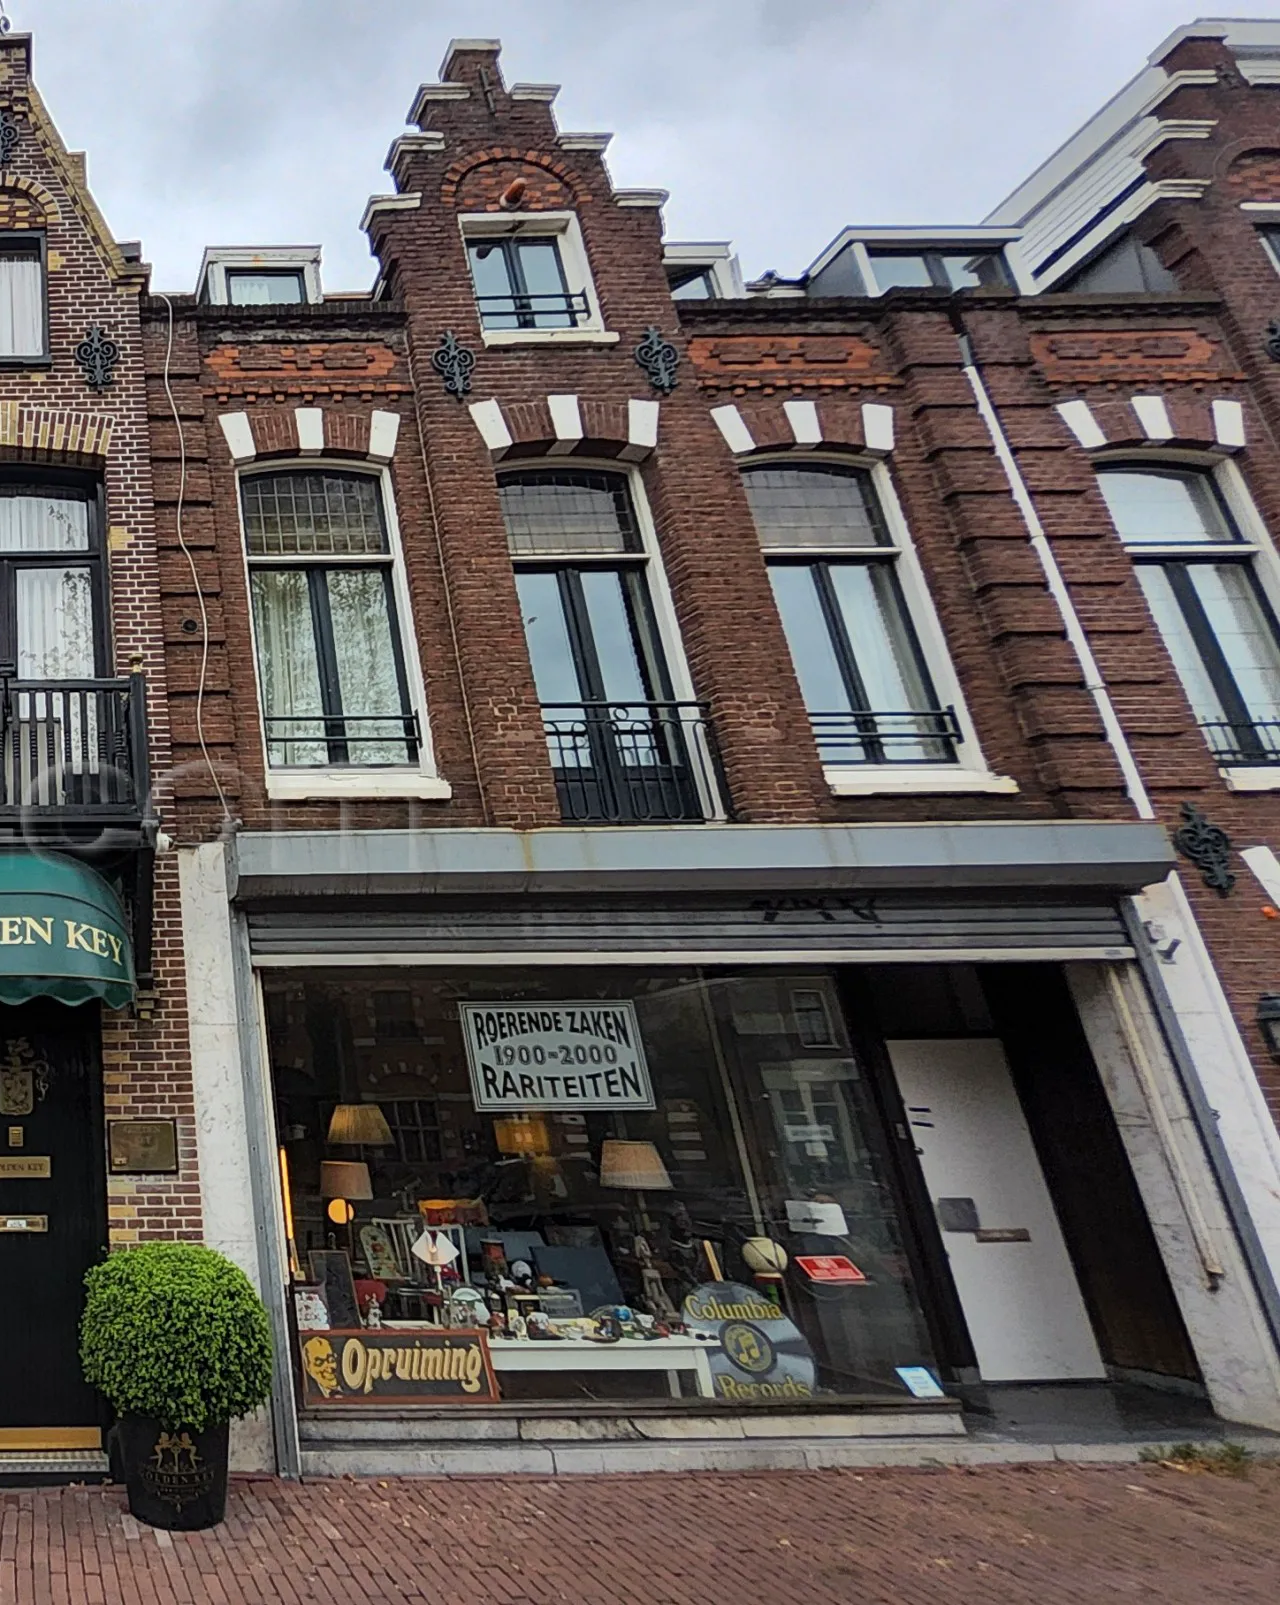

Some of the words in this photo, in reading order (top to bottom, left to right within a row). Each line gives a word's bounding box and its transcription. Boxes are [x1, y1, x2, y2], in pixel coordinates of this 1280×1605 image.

[62, 919, 124, 967] KEY
[472, 1010, 564, 1051] ROERENDE
[564, 1009, 632, 1050] ZAKEN
[493, 1044, 618, 1066] 1900-2000
[480, 1060, 642, 1099] RARITEITEN
[27, 1163, 45, 1172] KEY
[684, 1295, 784, 1321] Columbia
[341, 1337, 482, 1395] Opruiming
[716, 1373, 813, 1402] Records
